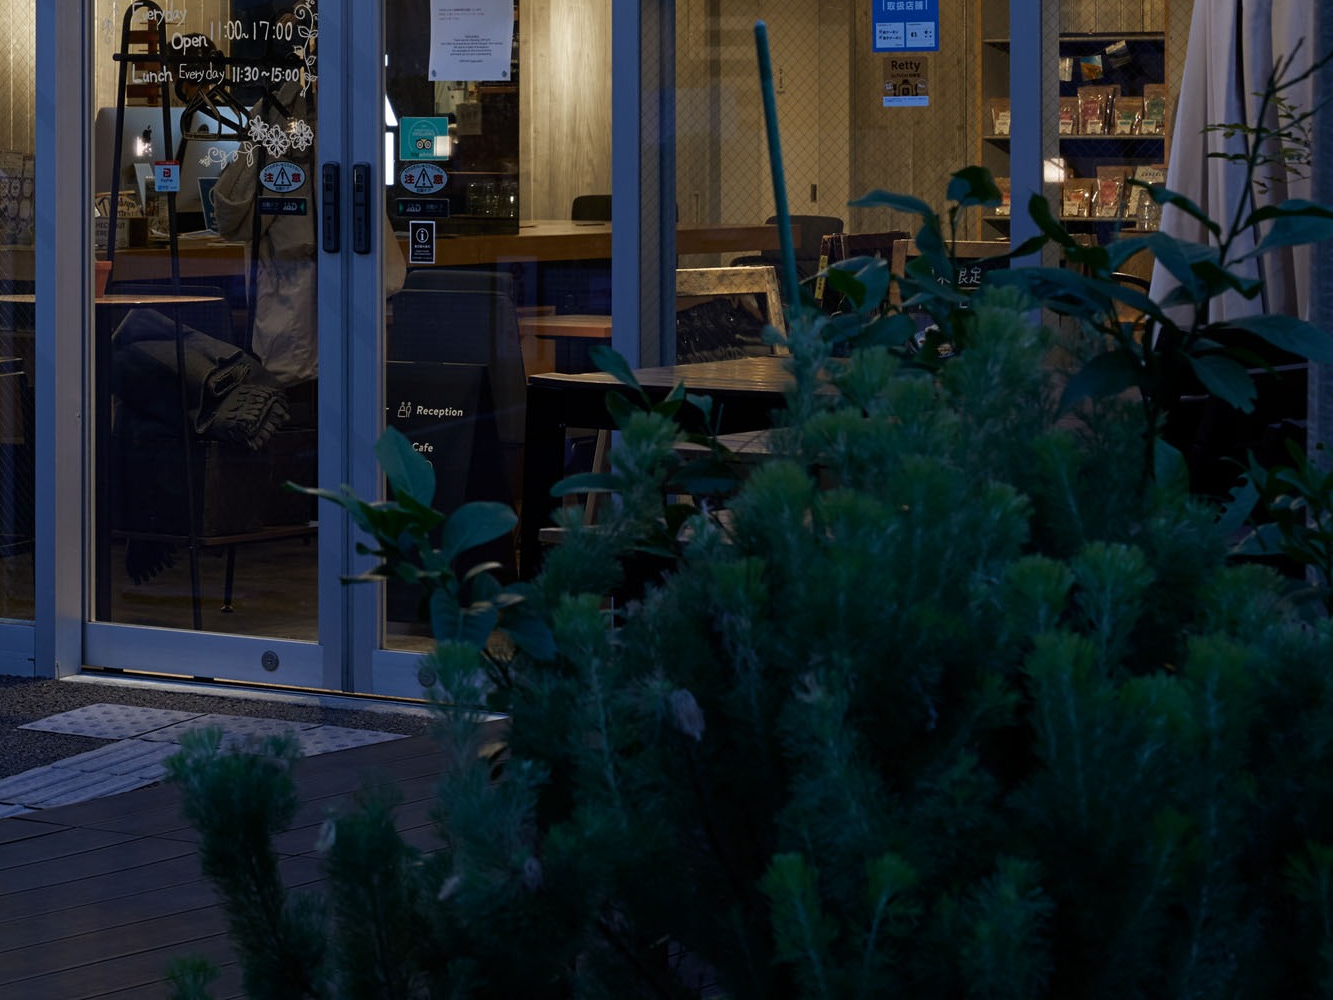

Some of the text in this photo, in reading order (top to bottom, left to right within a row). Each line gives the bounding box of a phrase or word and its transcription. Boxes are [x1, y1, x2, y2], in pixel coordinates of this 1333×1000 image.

[886, 1, 924, 11] 取扱店舗
[171, 33, 208, 56] Open
[891, 60, 921, 73] Retty
[131, 63, 173, 84] Lunch
[416, 405, 464, 419] Reception
[412, 442, 434, 453] Cafe
